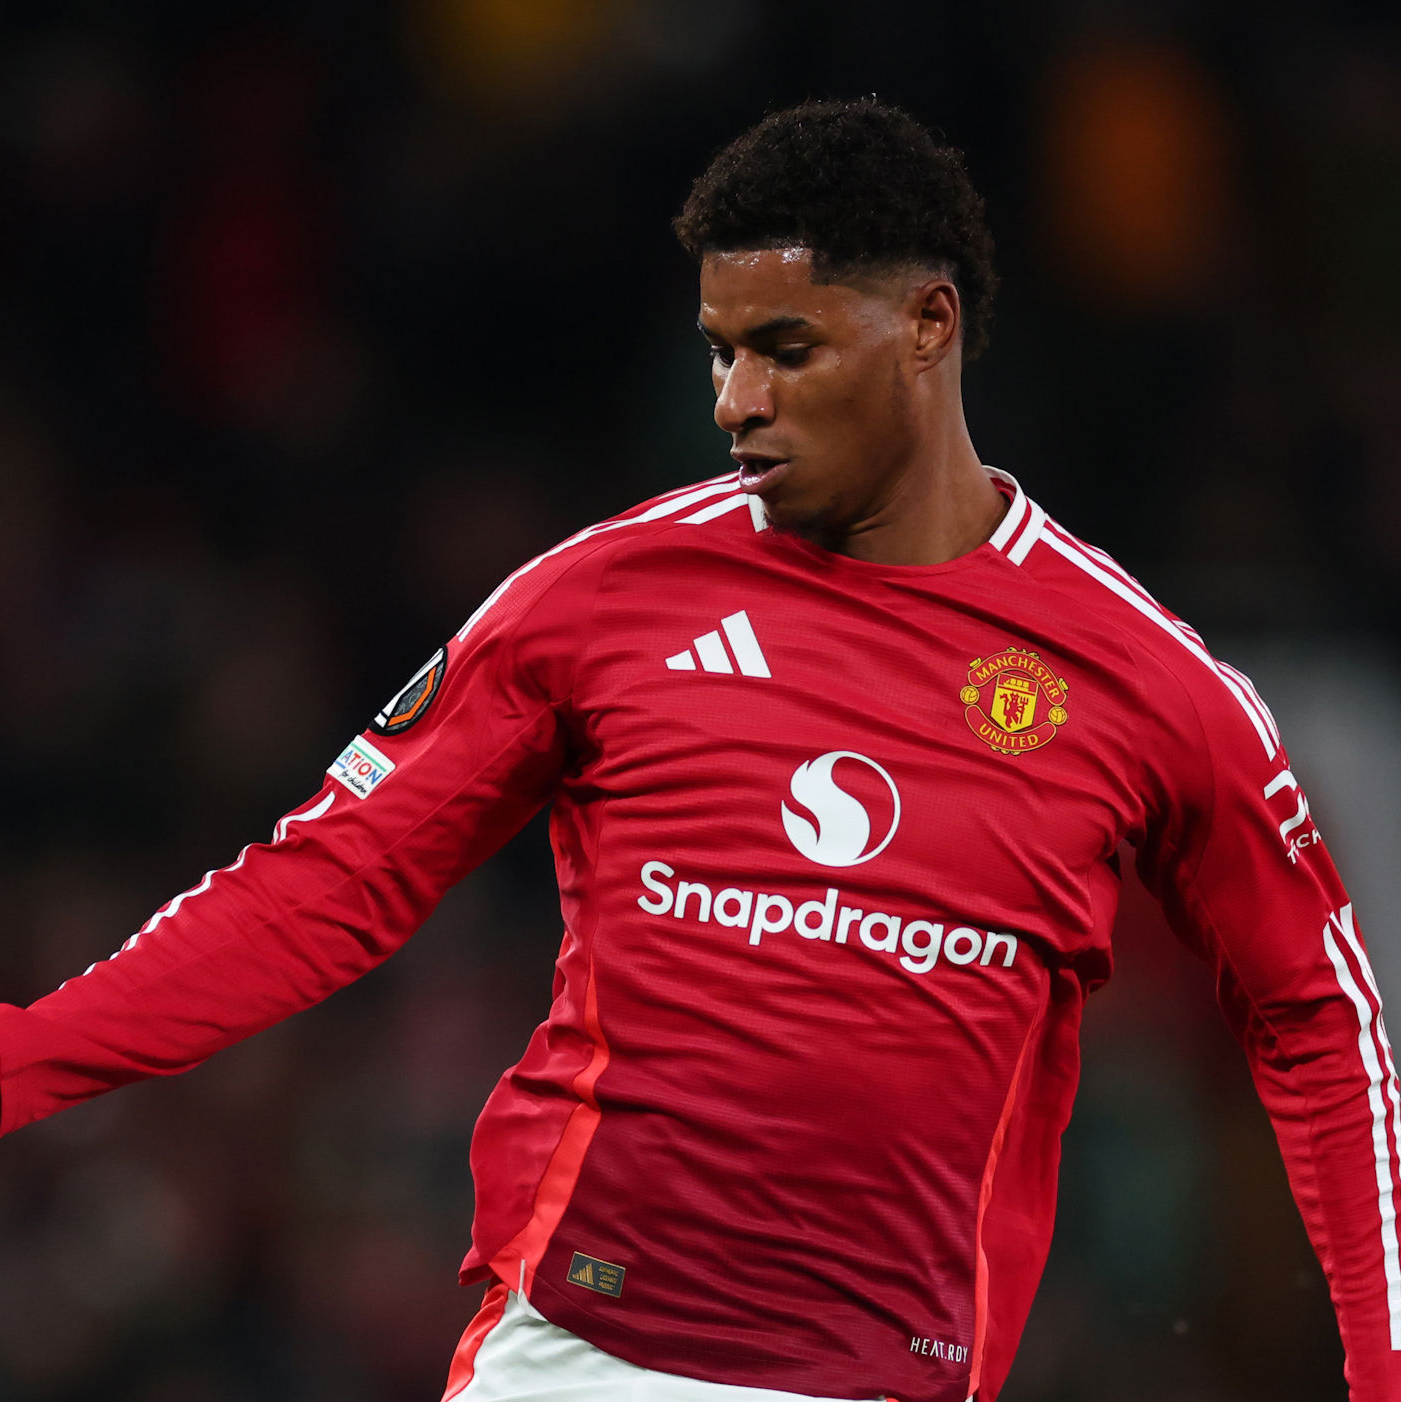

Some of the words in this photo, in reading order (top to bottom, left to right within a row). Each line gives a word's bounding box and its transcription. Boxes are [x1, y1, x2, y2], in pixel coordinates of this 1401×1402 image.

[975, 654, 1060, 698] MANCHESTER
[978, 723, 1039, 748] UNITED
[637, 860, 1018, 974] Snapdragon
[909, 1336, 969, 1364] HEAT.RDY
